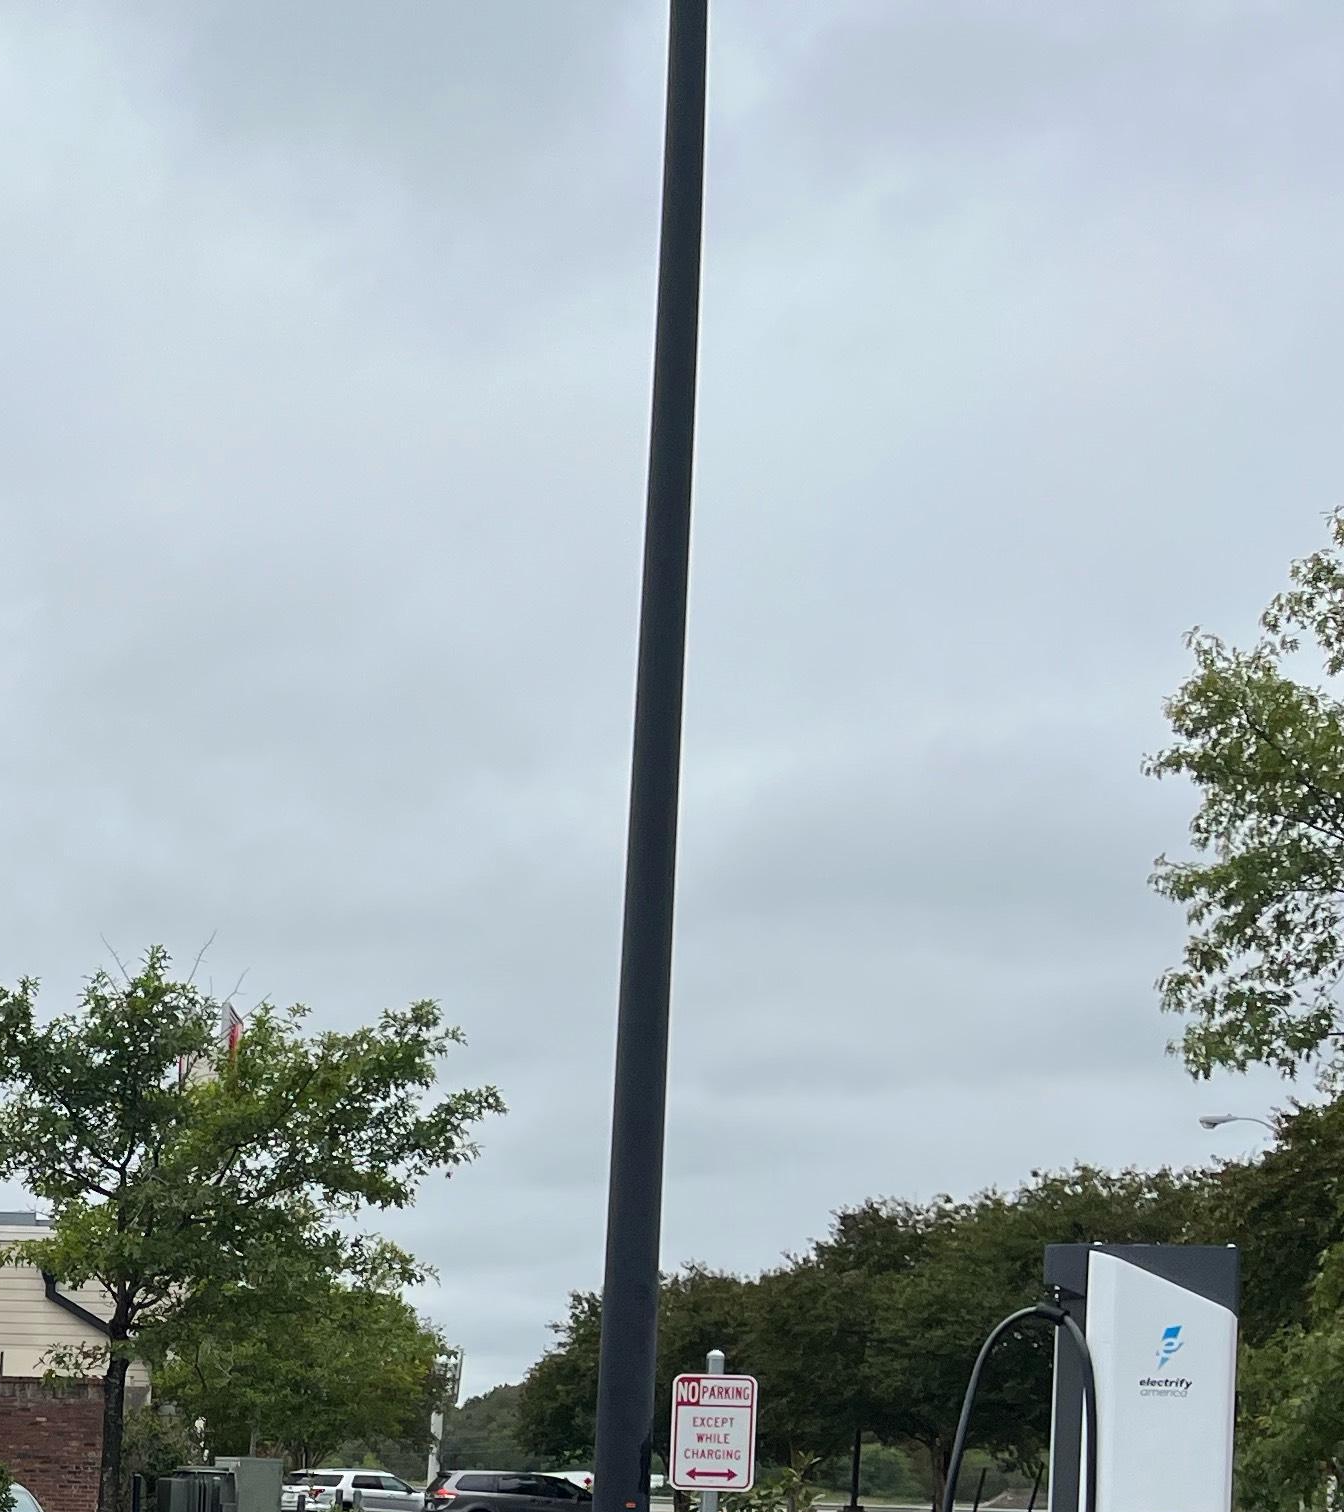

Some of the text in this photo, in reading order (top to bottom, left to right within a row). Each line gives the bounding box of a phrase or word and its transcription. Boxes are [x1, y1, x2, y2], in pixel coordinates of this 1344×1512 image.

[1139, 1377, 1193, 1390] electrify
[677, 1381, 750, 1403] NO PARKING
[692, 1416, 735, 1428] EXCEPT
[696, 1433, 730, 1444] WHILE
[683, 1448, 741, 1460] CHARGING
